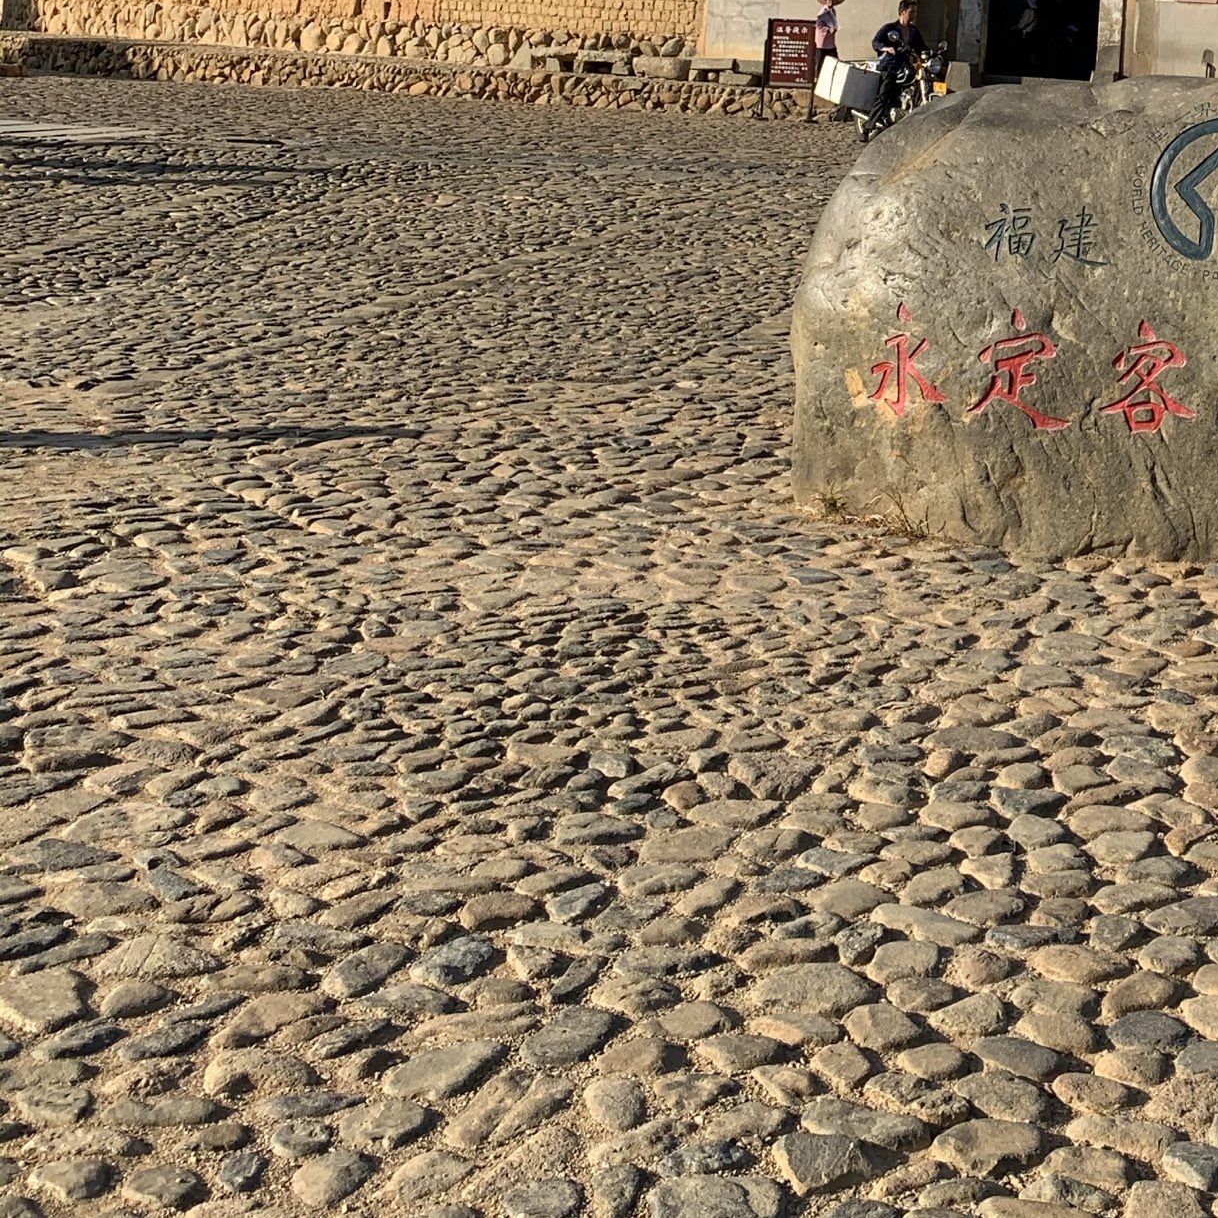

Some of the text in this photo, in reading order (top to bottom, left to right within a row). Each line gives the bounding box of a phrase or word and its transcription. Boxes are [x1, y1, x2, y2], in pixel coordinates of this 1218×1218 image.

[1132, 164, 1146, 216] WORLD
[984, 203, 1109, 265] 福建
[1138, 221, 1189, 275] HERITAGE
